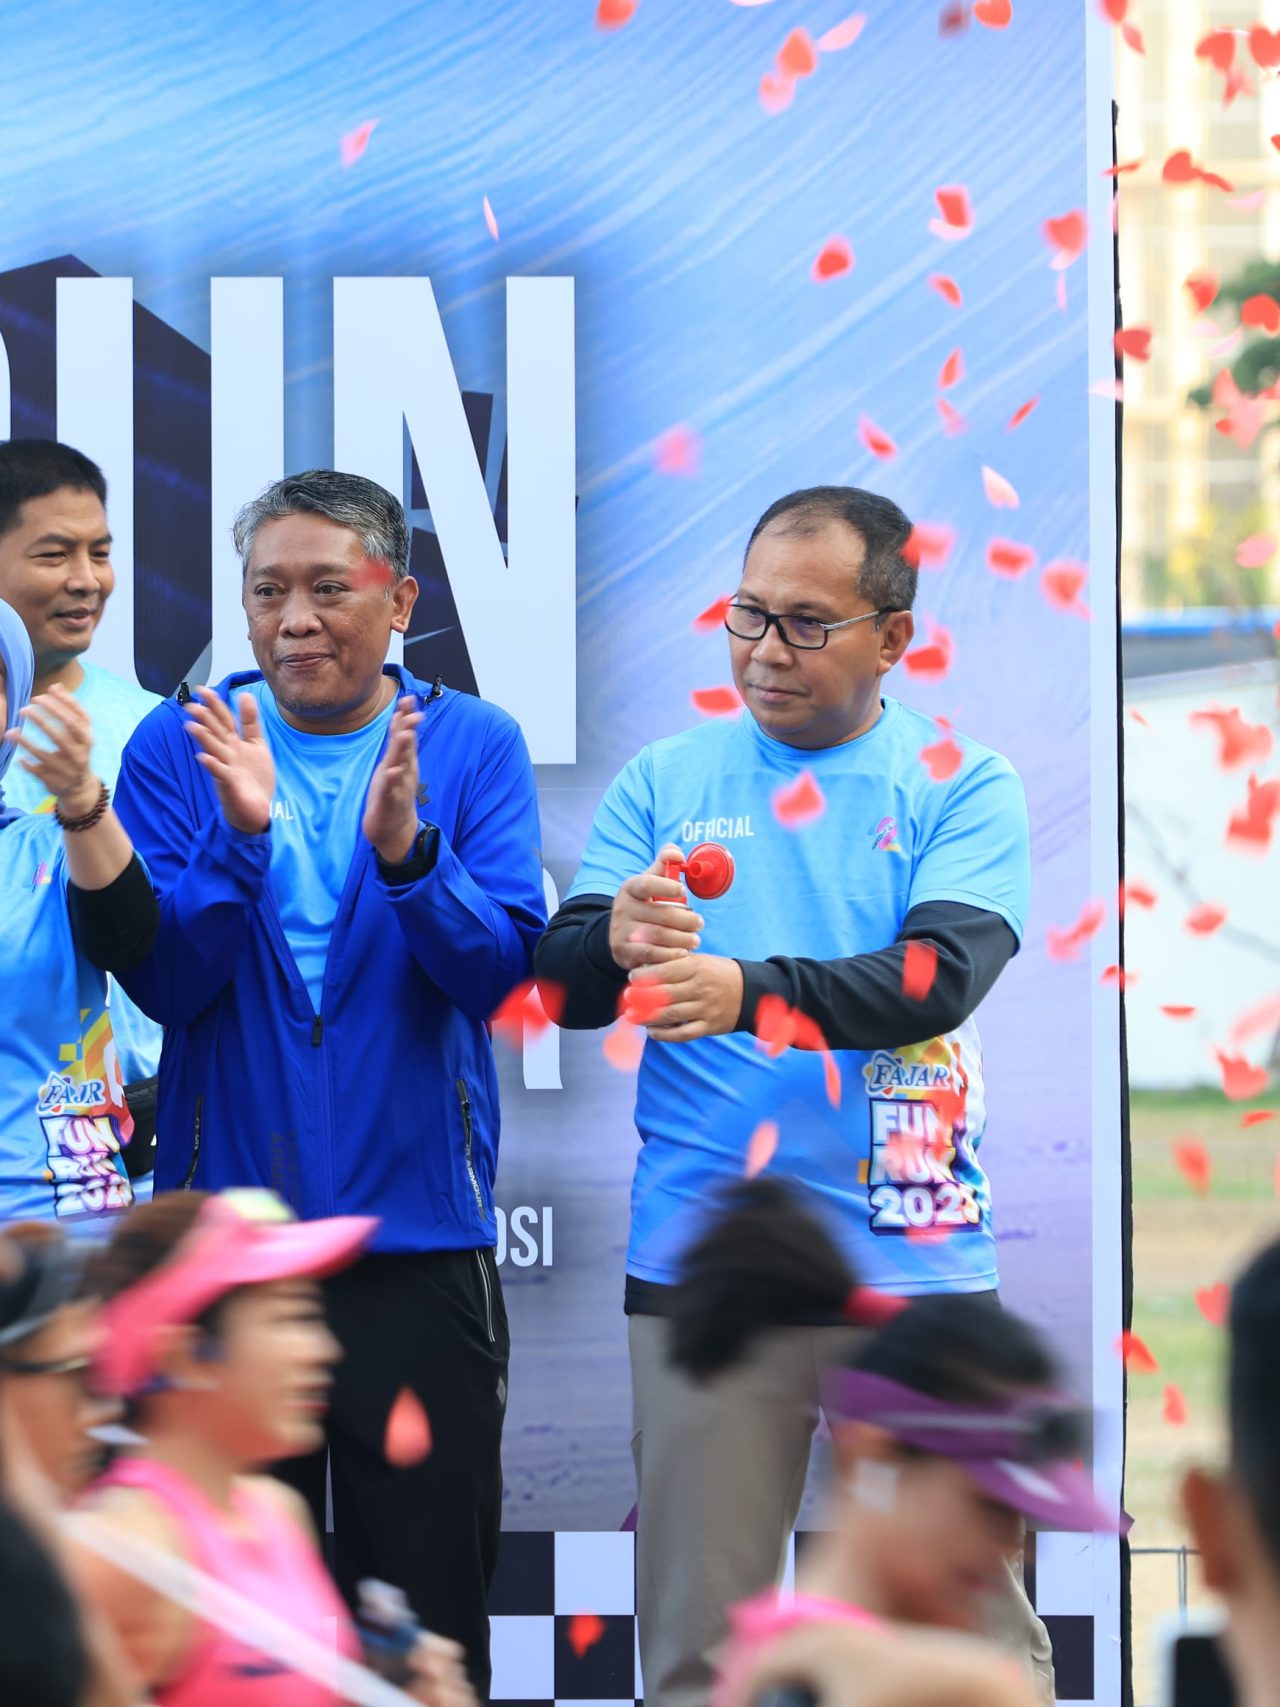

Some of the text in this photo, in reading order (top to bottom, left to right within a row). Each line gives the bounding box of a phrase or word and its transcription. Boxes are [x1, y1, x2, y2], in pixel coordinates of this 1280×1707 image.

[681, 815, 755, 842] OFFICIAL
[872, 1063, 950, 1087] FAJAR
[42, 1117, 120, 1157] FUN
